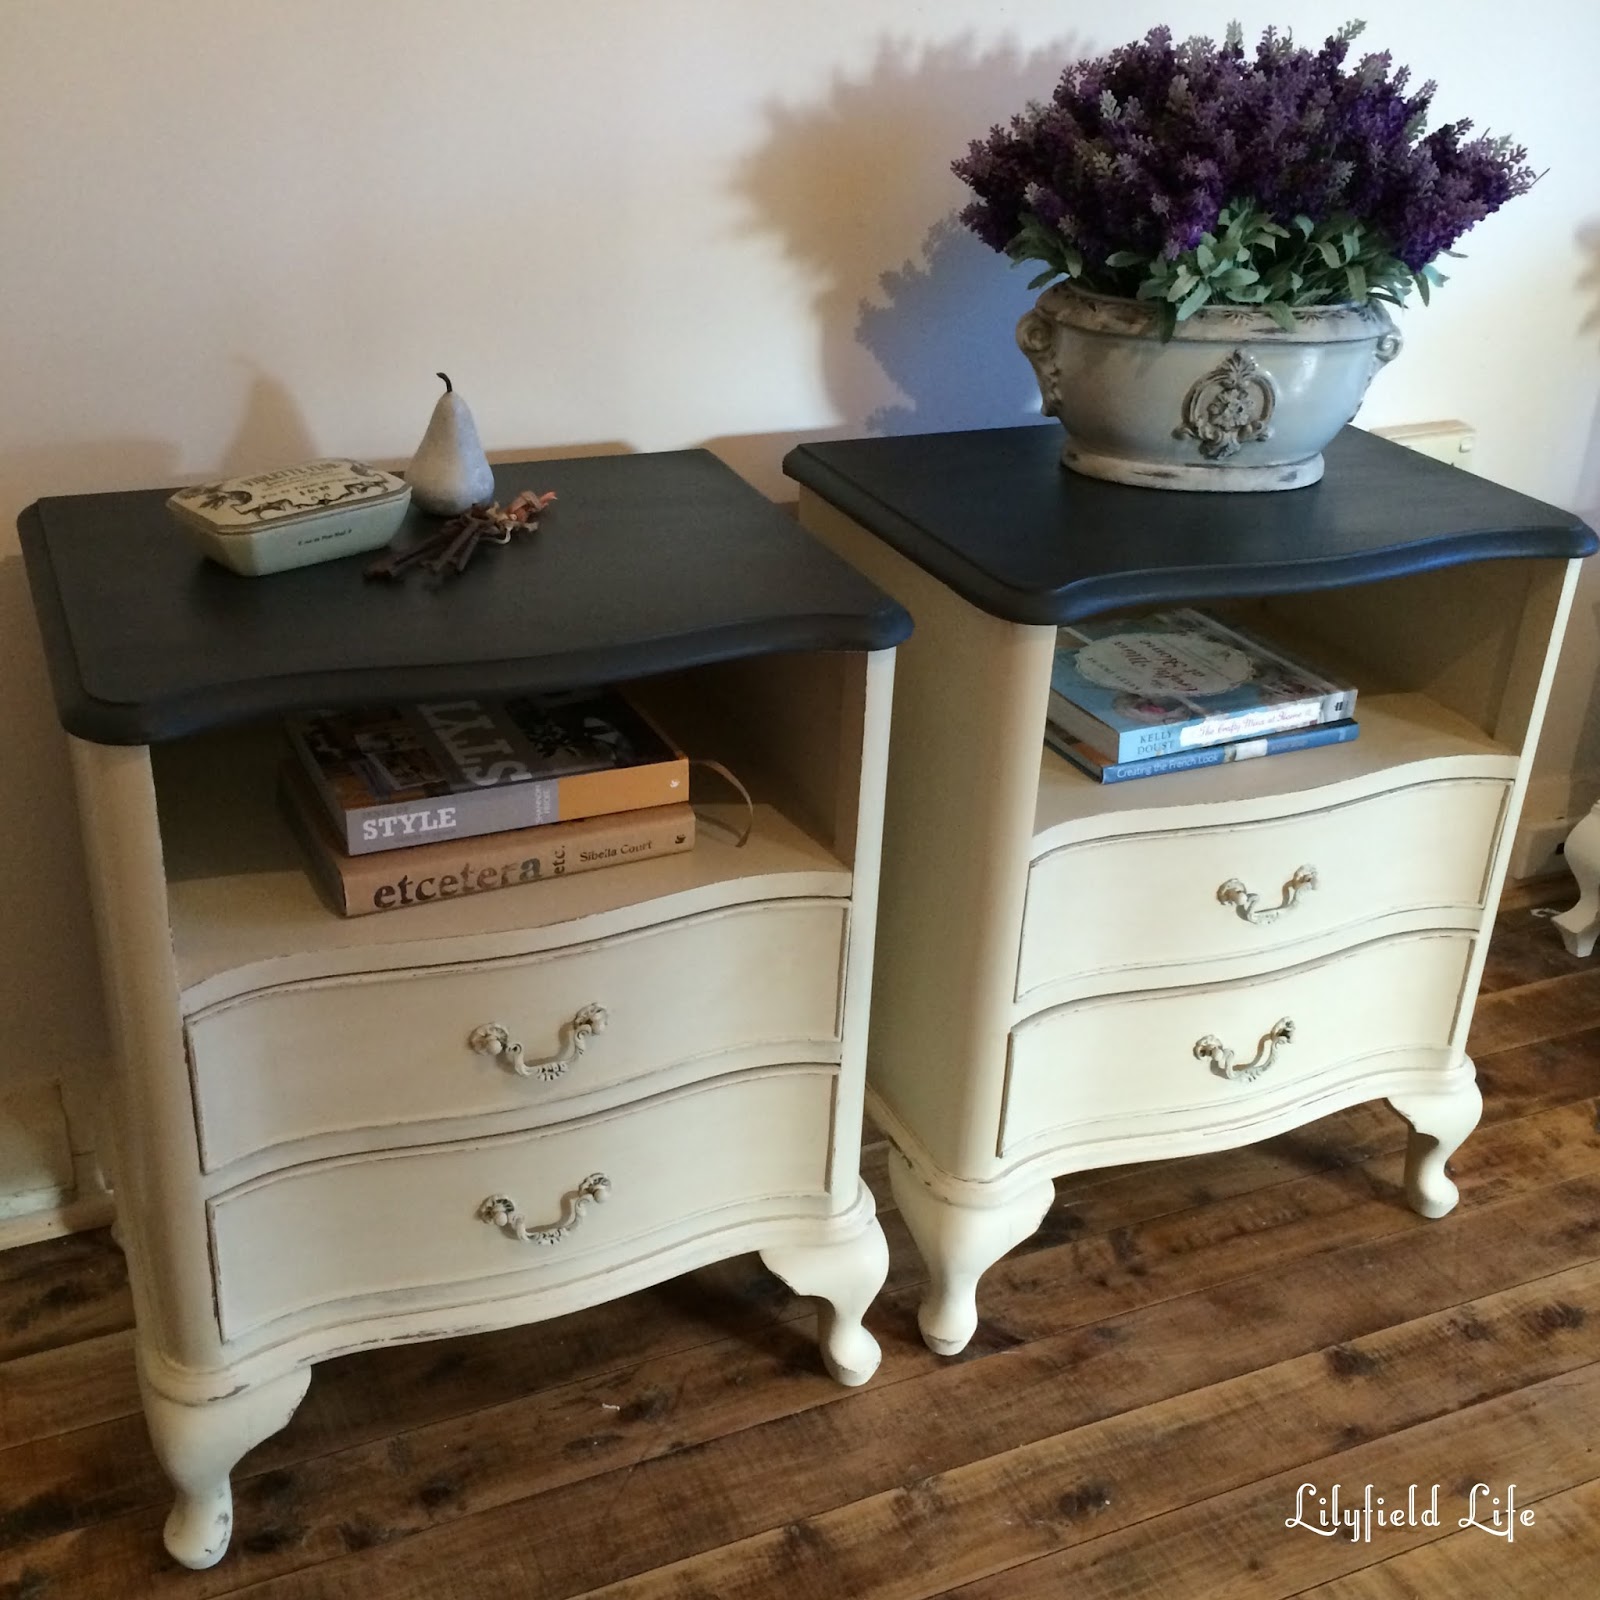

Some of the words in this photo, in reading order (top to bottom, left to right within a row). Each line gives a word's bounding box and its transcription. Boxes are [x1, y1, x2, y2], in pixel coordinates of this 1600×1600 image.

[416, 699, 533, 786] STYL
[1137, 740, 1174, 755] DOUST
[1140, 730, 1172, 743] KELLY
[1117, 765, 1152, 778] Creating
[1153, 761, 1167, 771] the
[1169, 757, 1197, 769] French
[1197, 753, 1218, 764] Look
[363, 807, 457, 841] STYLE
[373, 858, 544, 909] etcetera
[552, 845, 566, 875] etc.
[579, 847, 618, 863] Sibella
[620, 840, 653, 855] Court
